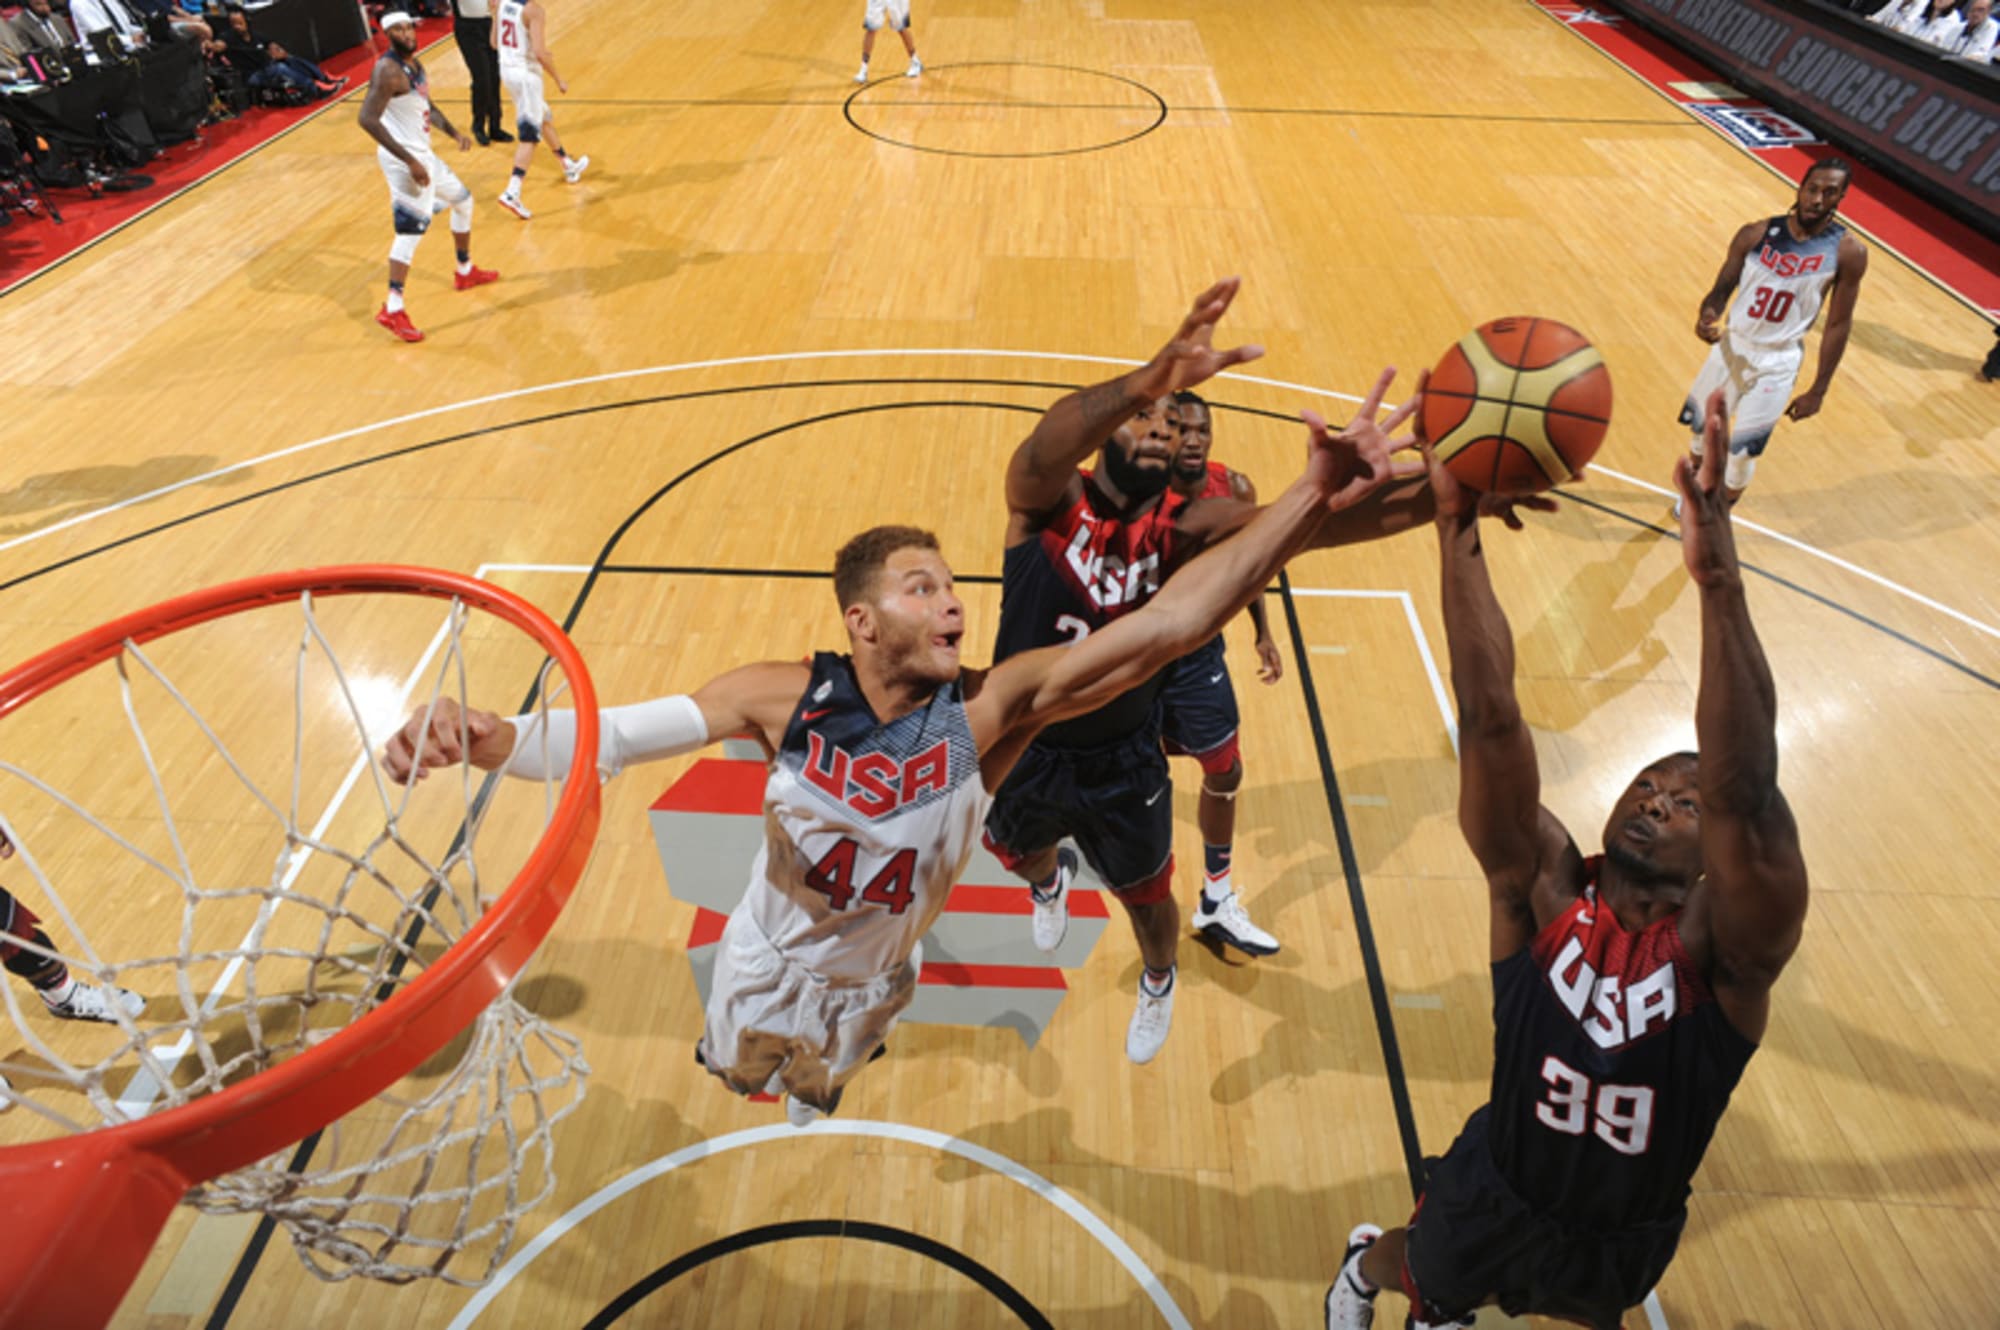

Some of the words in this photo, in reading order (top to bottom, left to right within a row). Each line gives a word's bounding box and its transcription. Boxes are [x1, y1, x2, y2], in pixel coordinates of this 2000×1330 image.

[501, 19, 518, 48] 21
[1775, 36, 1919, 131] SHOWCASE
[1894, 96, 2000, 171] BLUE
[1760, 244, 1825, 279] USA
[1747, 286, 1797, 324] 30
[1064, 523, 1159, 607] USA
[801, 728, 951, 820] USA
[804, 835, 918, 916] 44
[1548, 934, 1678, 1050] USA
[1534, 1053, 1657, 1155] 39
